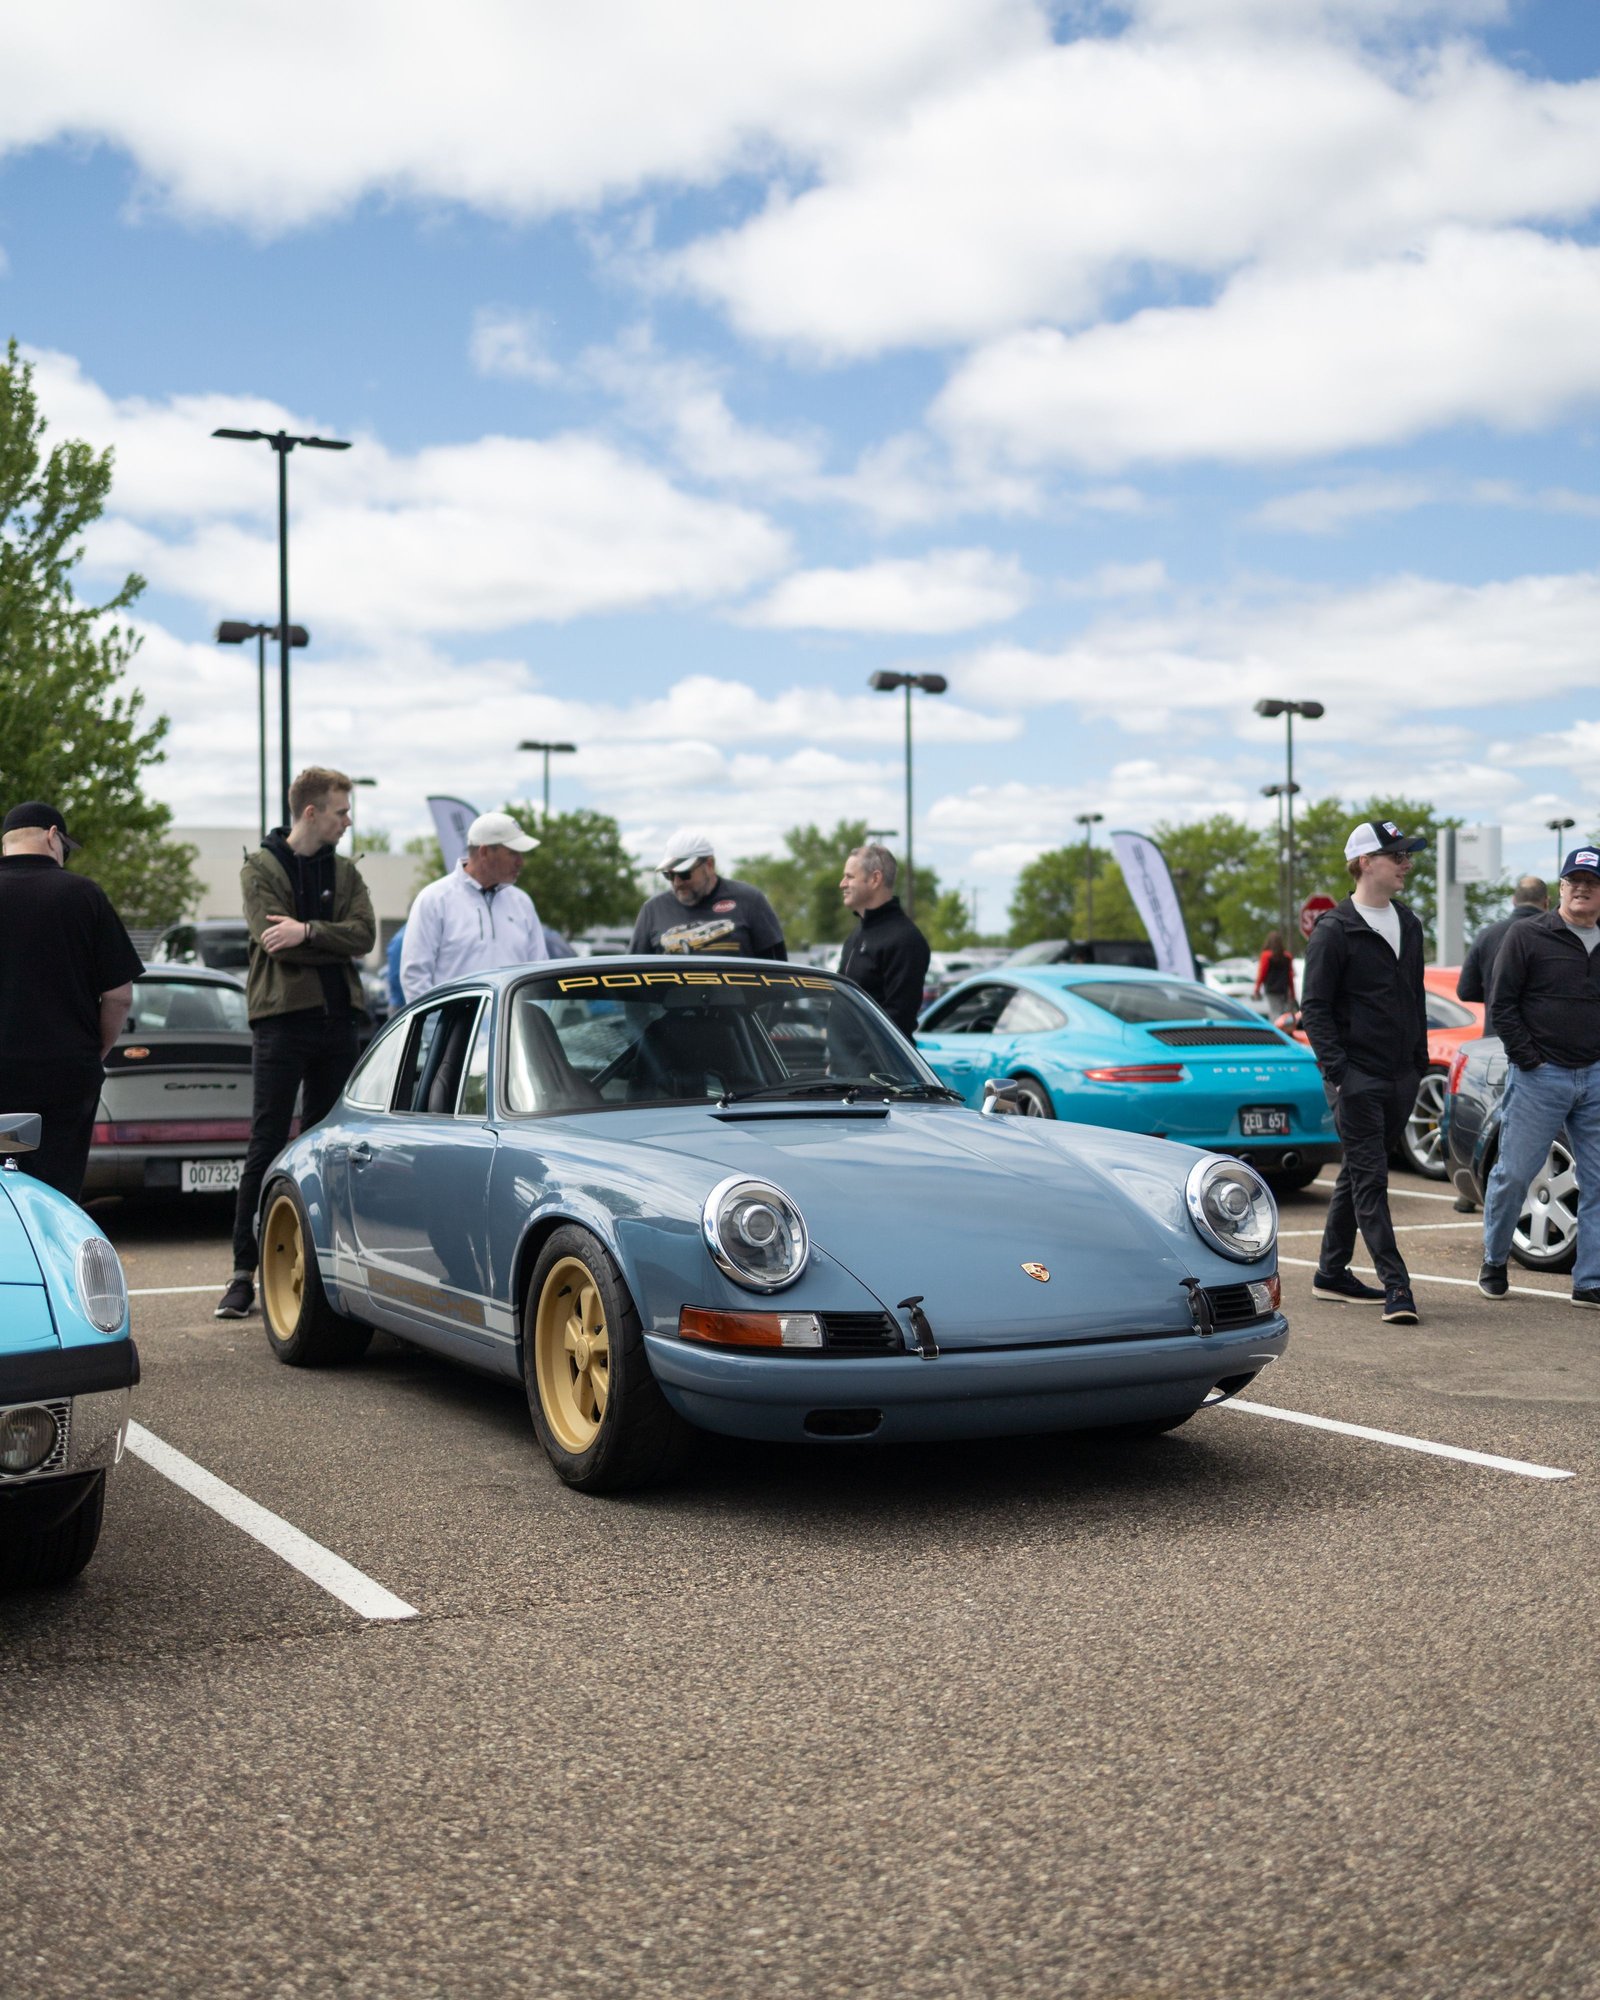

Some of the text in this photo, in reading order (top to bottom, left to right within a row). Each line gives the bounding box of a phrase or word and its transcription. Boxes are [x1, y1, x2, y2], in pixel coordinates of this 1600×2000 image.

[558, 972, 835, 992] PORSCHE
[1268, 1112, 1286, 1128] 657
[190, 1165, 239, 1184] 007323
[369, 1271, 484, 1326] PORSCHE
